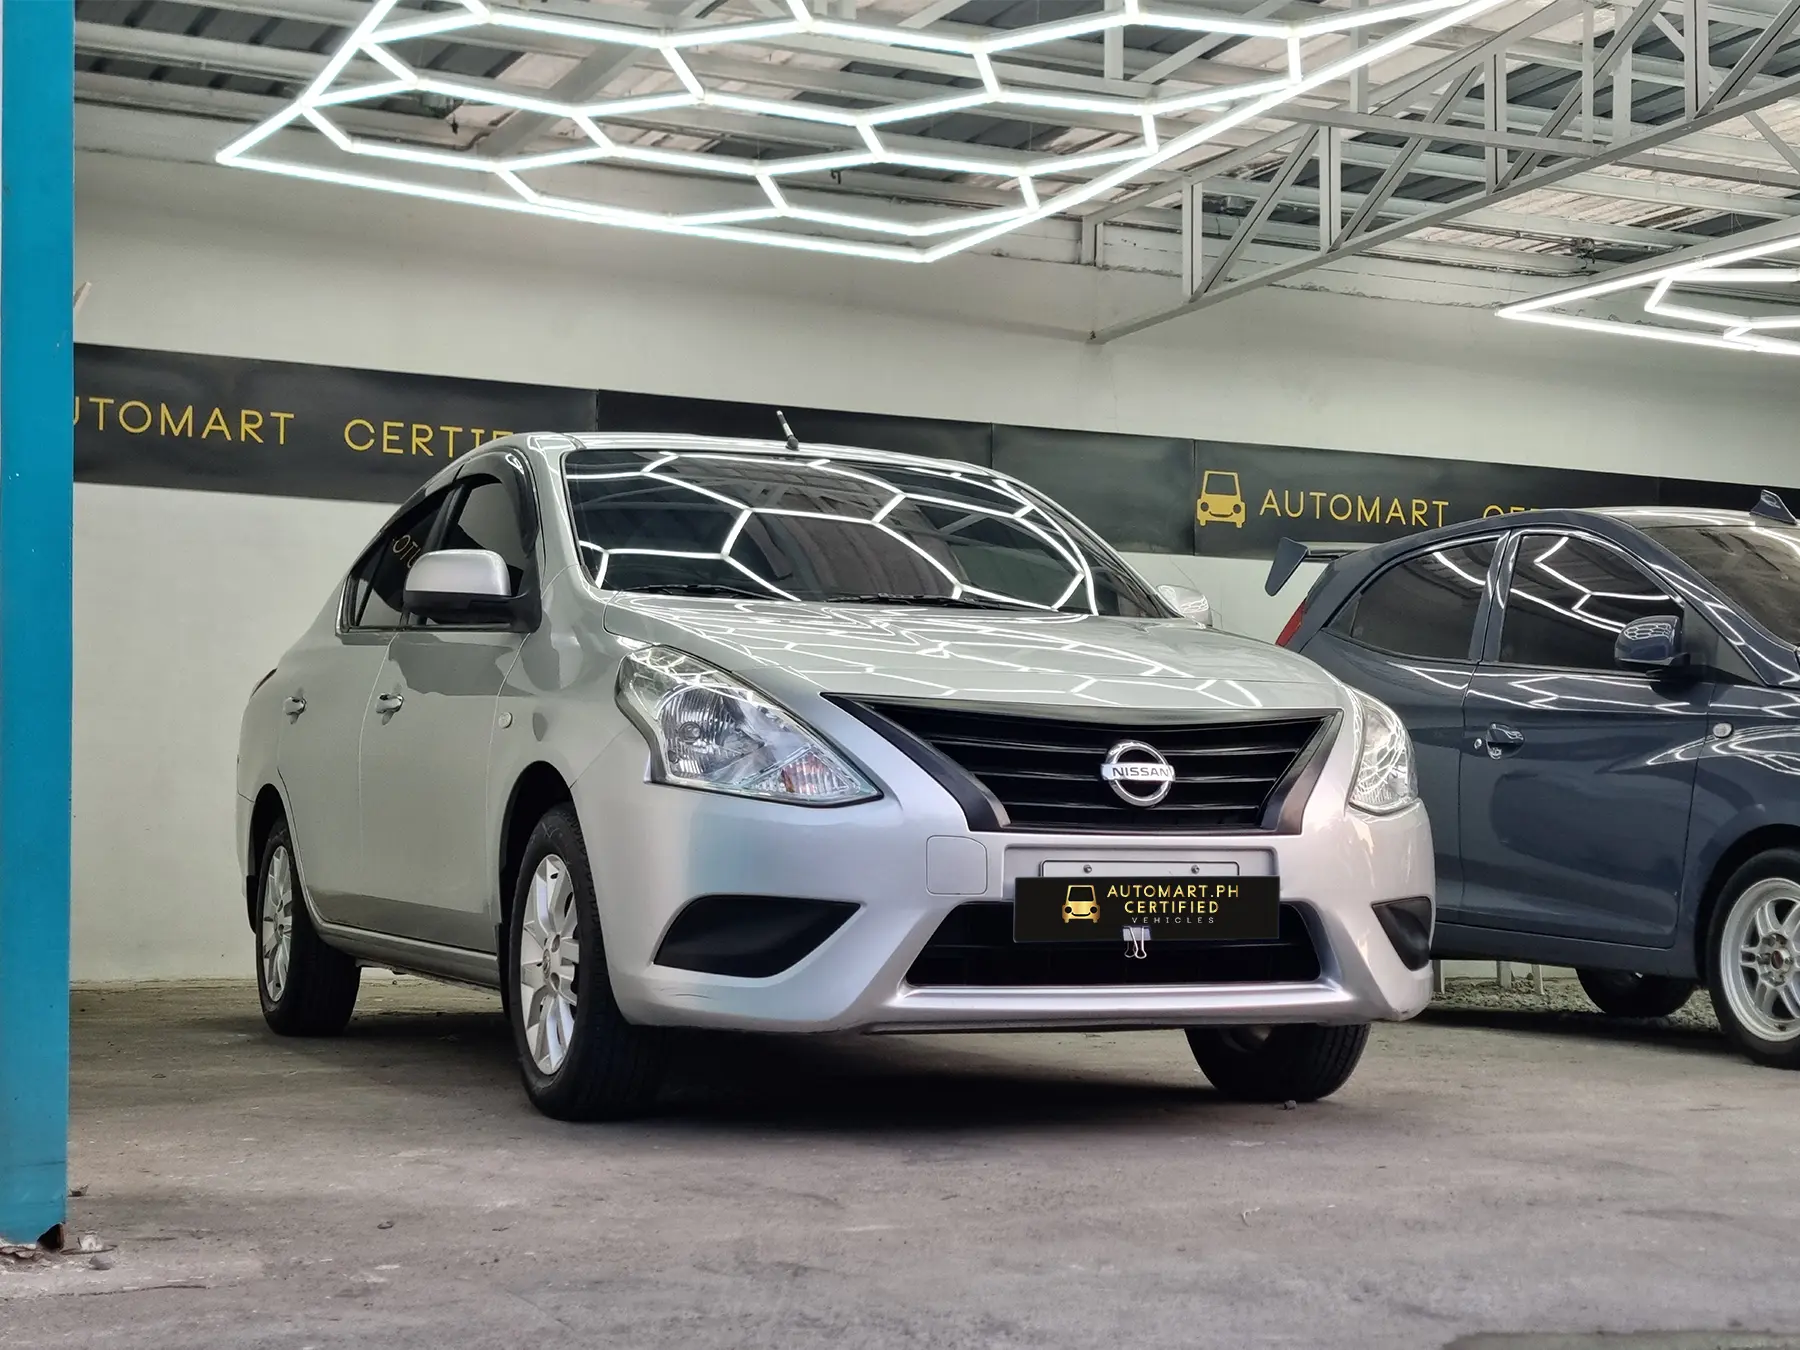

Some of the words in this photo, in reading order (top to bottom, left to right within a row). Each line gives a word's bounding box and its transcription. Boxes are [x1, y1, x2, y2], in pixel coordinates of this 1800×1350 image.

[1259, 488, 1449, 528] AUTOMART
[1112, 766, 1169, 777] NISSAN
[1106, 884, 1239, 898] AUTOMART.PH
[1124, 900, 1219, 914] CERTIFIED
[1131, 916, 1214, 924] VEHICLES
